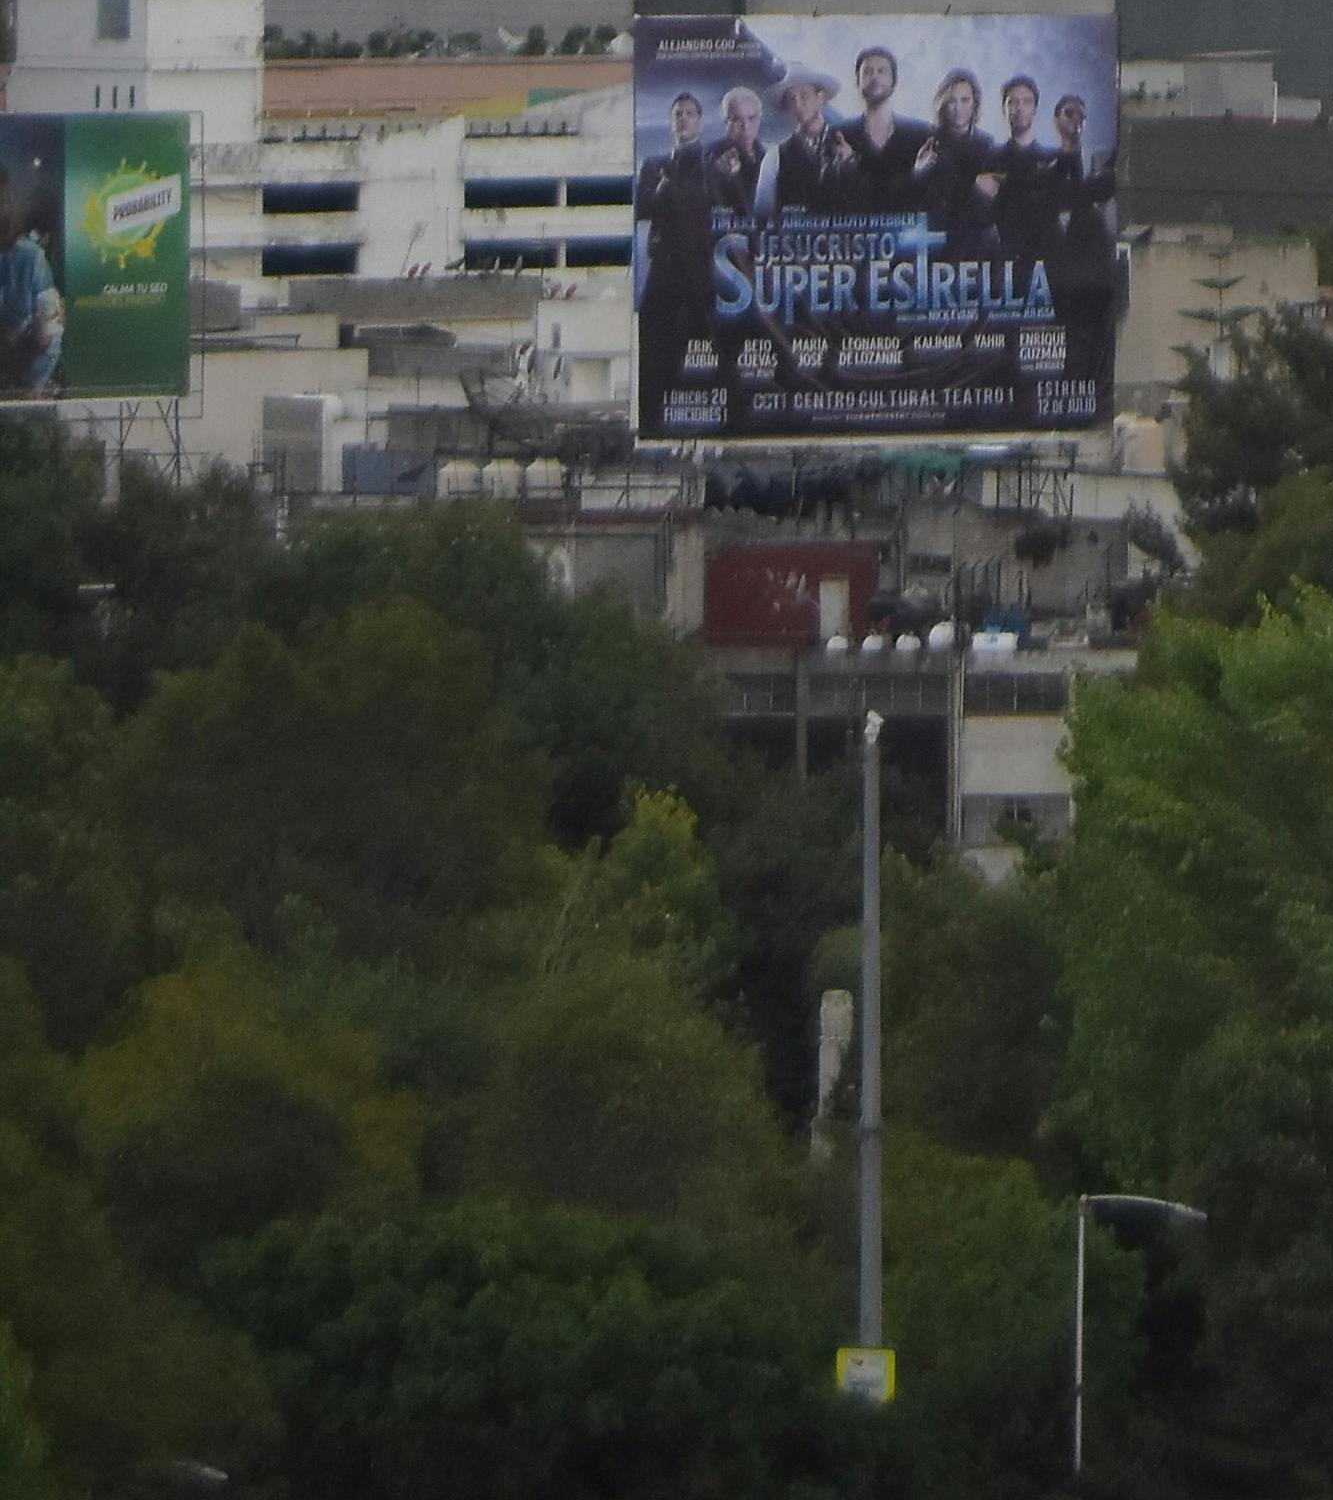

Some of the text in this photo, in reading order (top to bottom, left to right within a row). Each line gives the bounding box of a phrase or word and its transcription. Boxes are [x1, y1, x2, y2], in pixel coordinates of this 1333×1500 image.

[658, 39, 712, 50] ALEJANDRO
[782, 215, 831, 229] ANDREW
[755, 231, 896, 262] JESUCRISTO
[869, 218, 1053, 311] ESTRELLA
[687, 339, 712, 352] ERIK
[842, 337, 901, 350] LEONARDO
[913, 335, 962, 349] KALIMBA
[974, 334, 1005, 348] YAHIR
[1019, 332, 1066, 346] ENRIQUE
[737, 353, 778, 367] CUEVAS
[839, 352, 854, 366] DE
[1037, 379, 1095, 397] ESTRENO
[711, 388, 727, 404] 20
[793, 391, 855, 409] CENTRO
[858, 389, 938, 407] CULTURAL
[943, 387, 1004, 405] TEATRO
[1038, 397, 1096, 414] 12 DE JULIO
